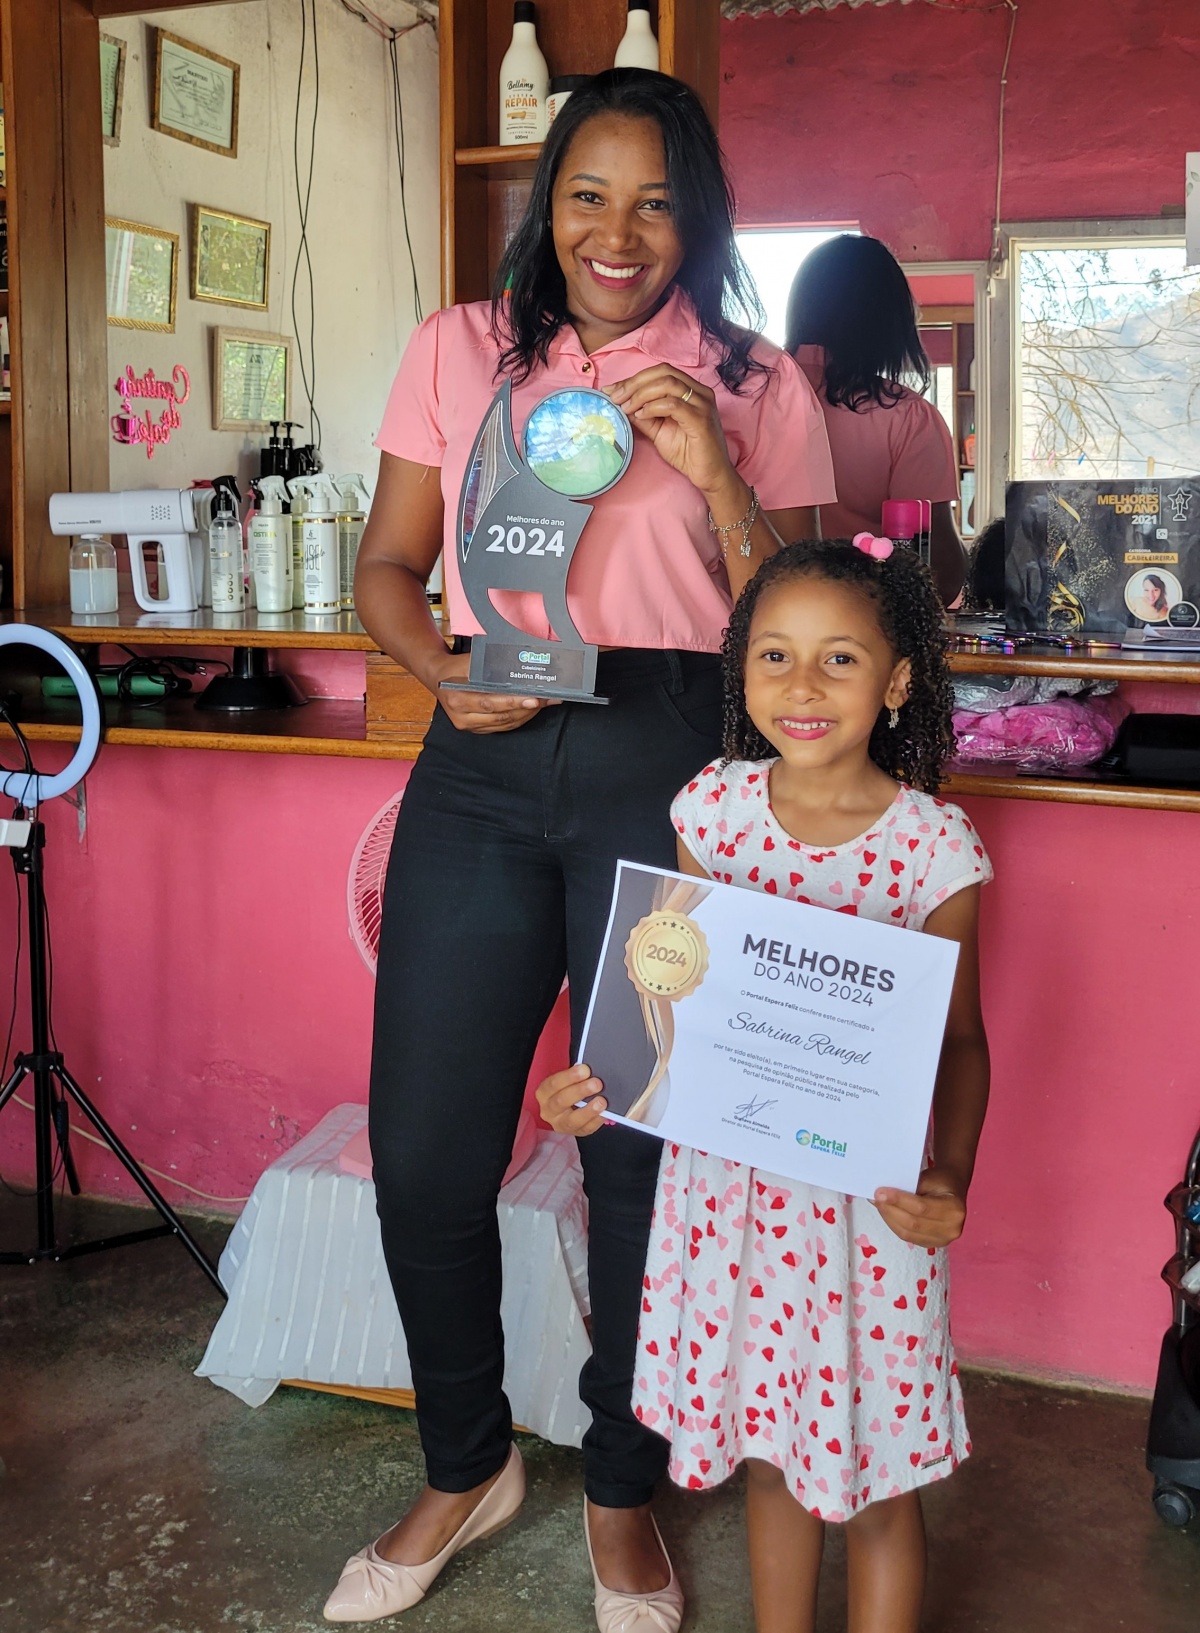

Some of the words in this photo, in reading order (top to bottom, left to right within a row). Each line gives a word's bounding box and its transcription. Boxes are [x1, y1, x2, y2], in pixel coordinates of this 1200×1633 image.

[507, 80, 534, 91] Bellamy
[505, 97, 538, 108] REPAIR
[1097, 494, 1159, 505] MELHORES
[1115, 503, 1133, 514] DO
[1132, 503, 1159, 514] ANO
[506, 514, 540, 525] Melhores
[540, 517, 550, 525] do
[1131, 514, 1157, 525] 2021
[485, 524, 565, 558] 2024
[529, 652, 550, 661] Portal
[510, 671, 534, 680] Sabrina
[534, 673, 557, 682] Rangel
[645, 943, 687, 968] 2024
[743, 934, 895, 992] MELHORES
[754, 962, 780, 981] DO
[784, 971, 824, 992] ANO
[828, 982, 874, 1007] 2024
[746, 991, 764, 1001] Portal
[764, 996, 784, 1007] Espera
[785, 1002, 799, 1011] Feliz
[799, 1006, 822, 1018] confere
[822, 1013, 836, 1022] este
[836, 1017, 870, 1031] certificado
[728, 1012, 804, 1046] Sabrina
[803, 1033, 872, 1065] Rangel
[734, 1048, 746, 1057] sido
[773, 1060, 783, 1068] em
[783, 1064, 809, 1076] primeiro
[809, 1070, 825, 1080] lugar
[836, 1079, 848, 1087] sua
[737, 1059, 763, 1070] pesquisa
[794, 1075, 817, 1086] pública
[817, 1082, 845, 1095] realizada
[845, 1090, 860, 1099] pelo
[742, 1068, 761, 1078] Portal
[760, 1073, 781, 1084] Espera
[781, 1080, 795, 1089] Feliz
[804, 1087, 816, 1095] ano
[825, 1093, 841, 1102] 2024
[812, 1133, 847, 1153] Portal
